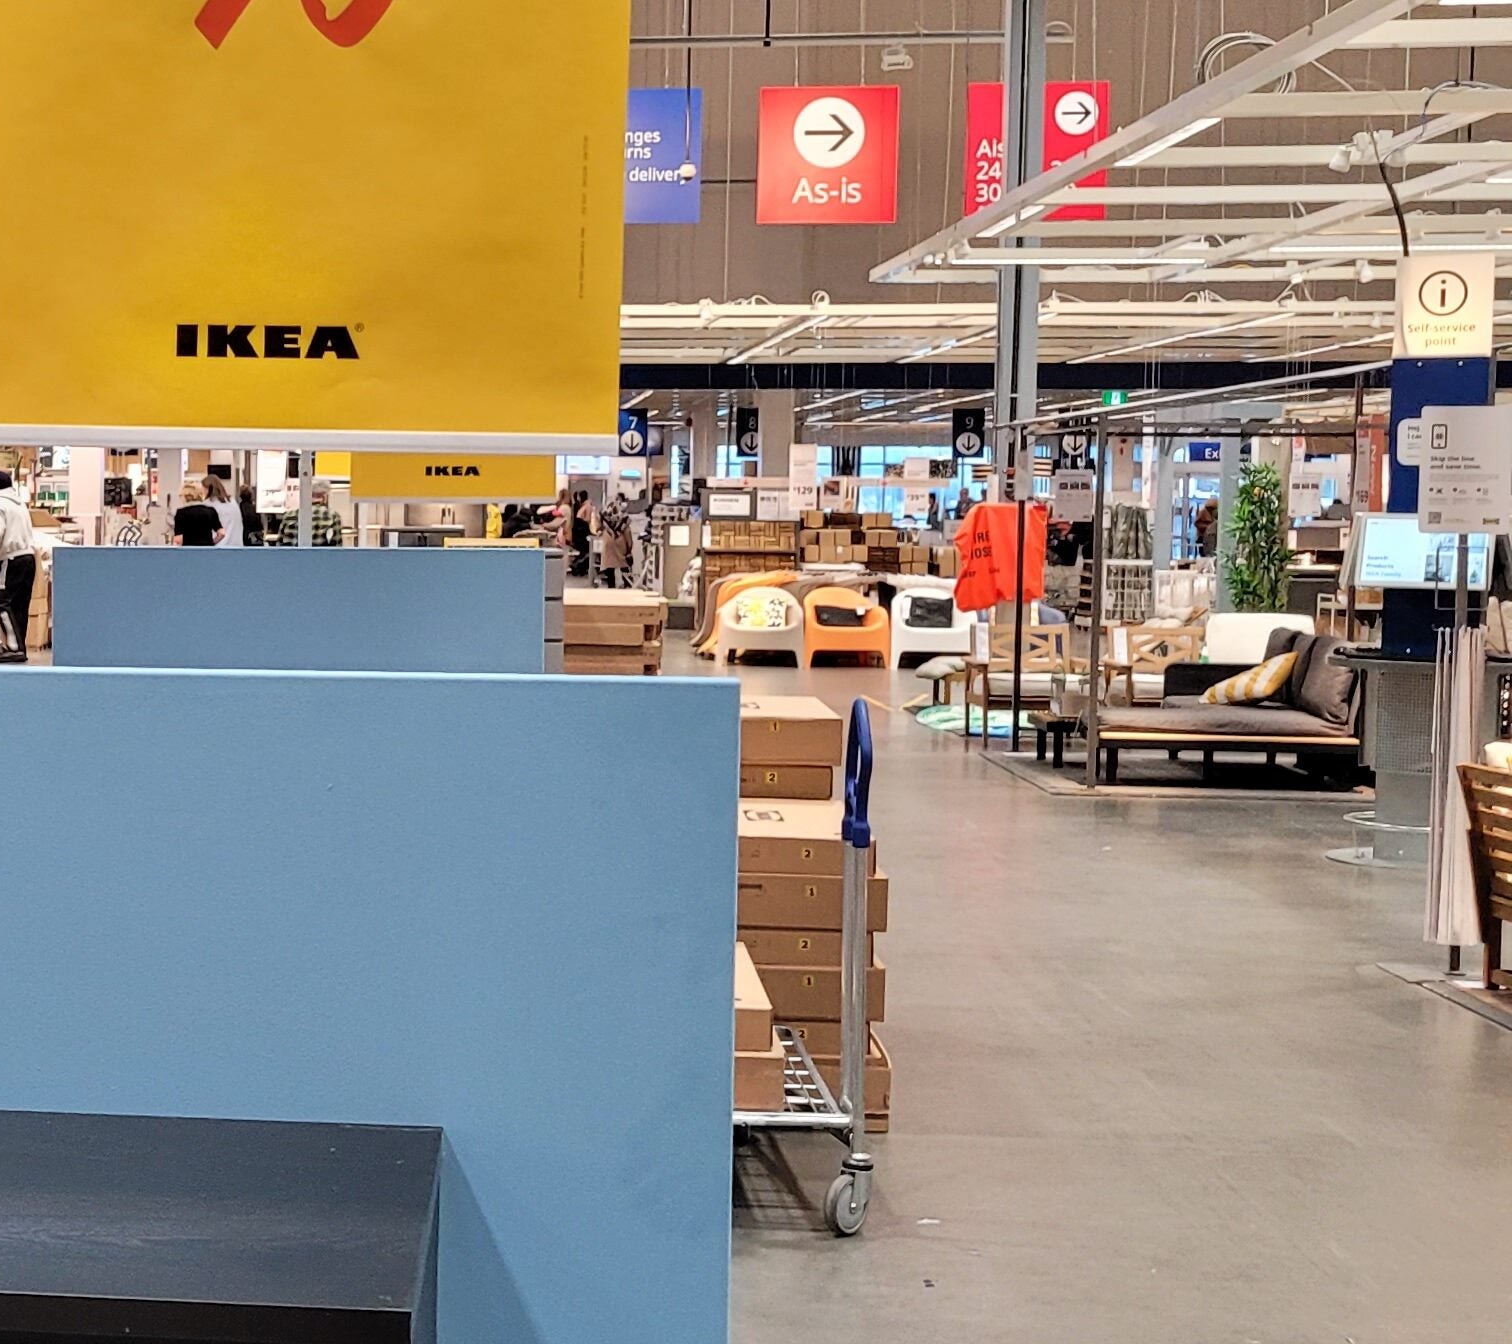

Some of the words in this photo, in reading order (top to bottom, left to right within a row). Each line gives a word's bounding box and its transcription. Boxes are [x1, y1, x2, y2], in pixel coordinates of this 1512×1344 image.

[624, 131, 661, 146] nges
[976, 138, 1004, 158] Ais
[792, 177, 862, 204] As-is
[1408, 323, 1476, 334] Self-service
[176, 324, 360, 360] IKEA
[1425, 337, 1456, 348] point
[628, 416, 638, 430] 7
[966, 417, 974, 429] 9
[1205, 448, 1220, 459] Ex
[424, 465, 481, 477] IKEA
